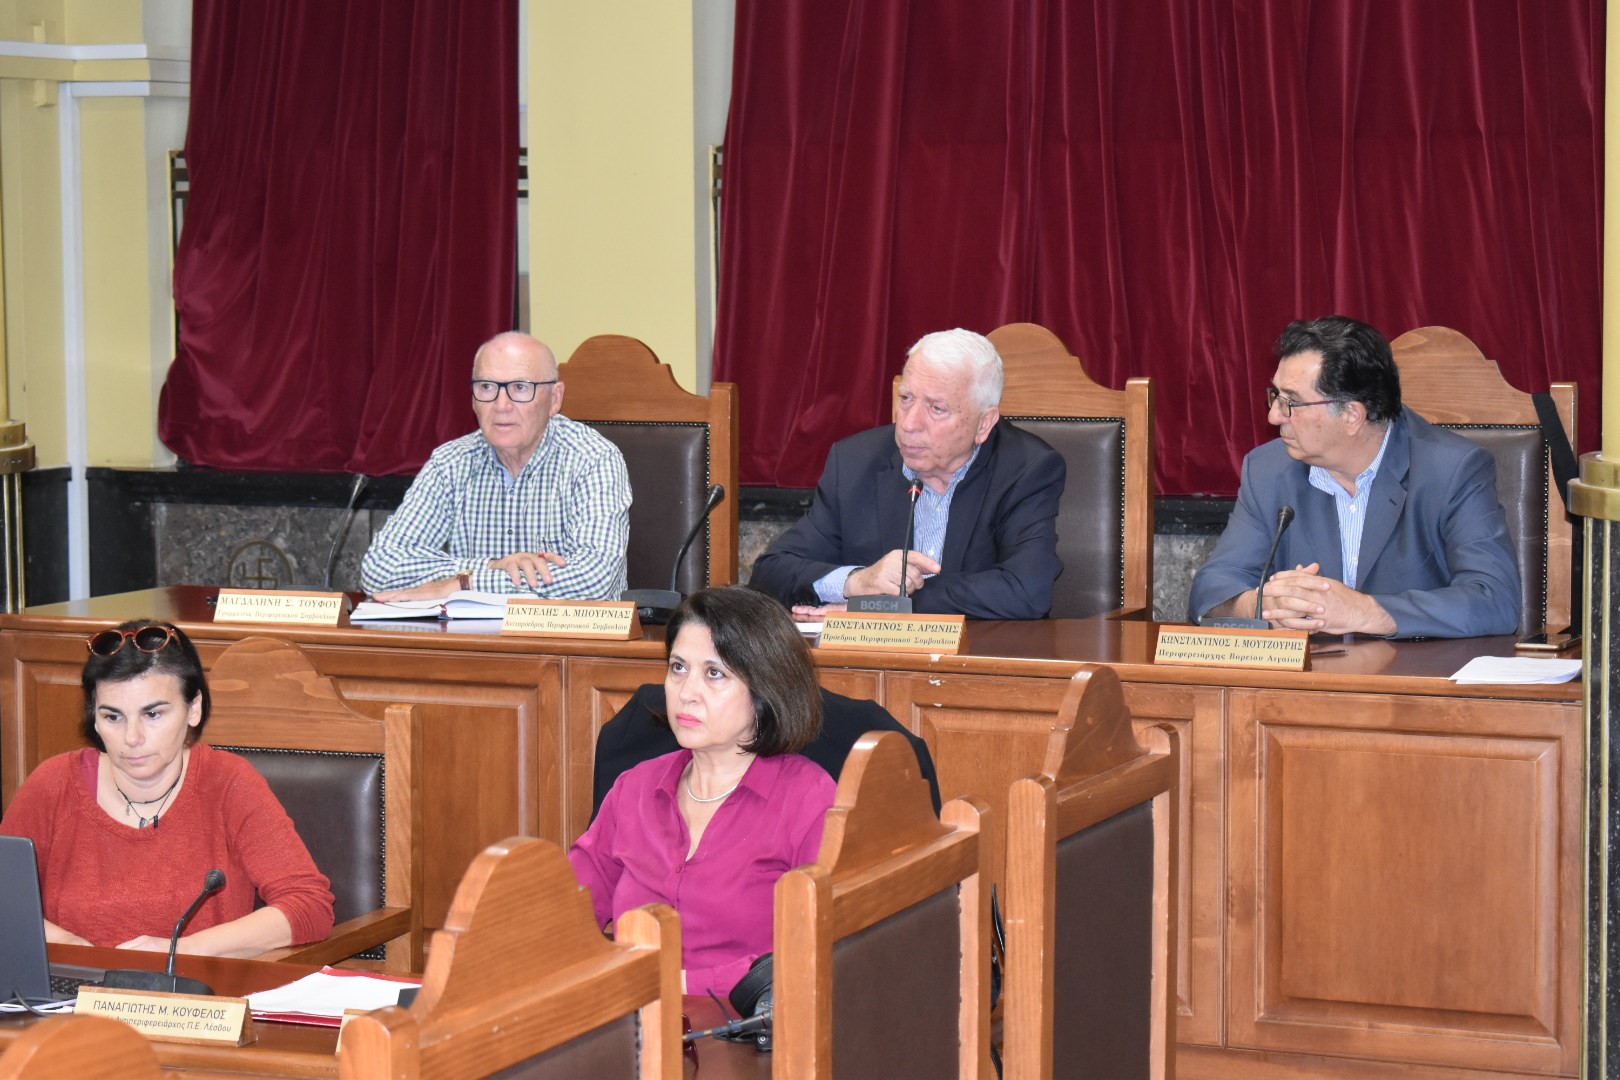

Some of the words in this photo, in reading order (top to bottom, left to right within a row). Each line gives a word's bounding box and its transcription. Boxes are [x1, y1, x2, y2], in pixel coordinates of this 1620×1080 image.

[220, 597, 280, 607] ΜΑΓΔΑΛΗΝΗ
[285, 599, 294, 607] Σ.
[299, 599, 339, 608] ΤΟΥΦΟΥ
[860, 600, 899, 611] BOSCH
[507, 607, 558, 616] ΠΑΝΤΕΛΗΣ
[573, 609, 631, 619] ΜΠΟΥΡΝΙΑΣ
[826, 620, 903, 631] ΚΩΝΣΤΑΝΤΙΝΟΣ
[907, 623, 916, 632] Ε.
[918, 624, 960, 634] ΑΡΩΝΗΣ
[1160, 635, 1231, 647] ΚΩΝΣΤΑΝΤΙΝΟΣ
[1241, 639, 1304, 650] ΜΟΥΤΖΟΥΡΗΣ
[1158, 649, 1226, 660] Περιφερειάρχης
[1267, 654, 1301, 664] Αιγαίου
[93, 1000, 156, 1015] ΠΑΝΑΓΙΩΤΗΣ
[158, 1006, 169, 1016] Μ.
[172, 1006, 227, 1020] ΚΟΥΦΕΛΟΣ
[203, 1022, 232, 1033] Λέσβου
